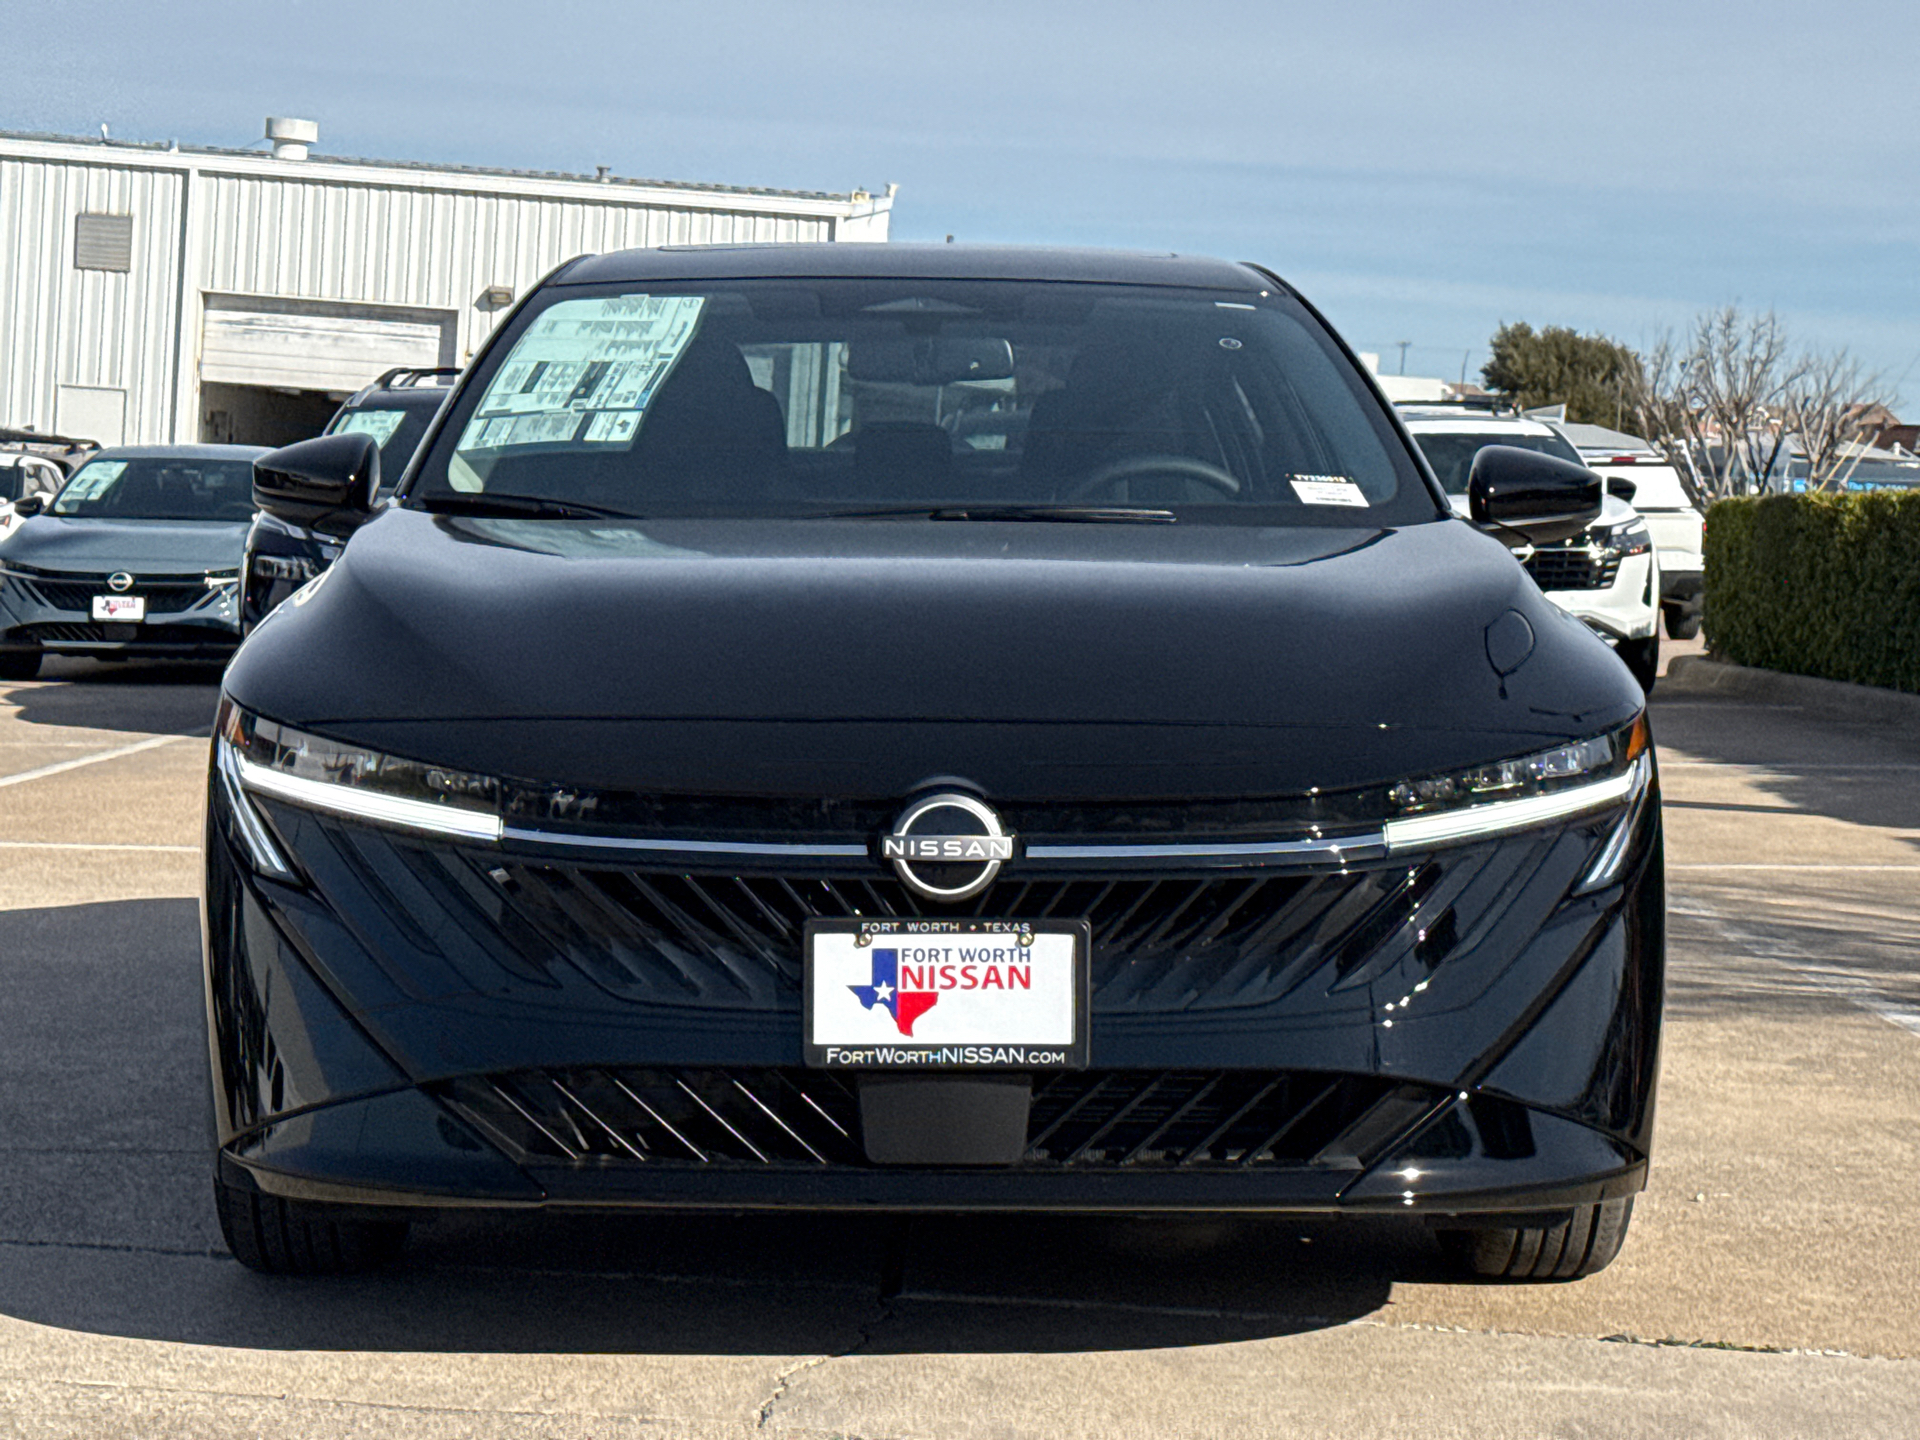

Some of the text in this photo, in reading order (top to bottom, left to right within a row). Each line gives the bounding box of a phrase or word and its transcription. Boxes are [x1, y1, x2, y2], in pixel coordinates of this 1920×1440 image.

[885, 839, 1008, 857] NISSAN
[861, 922, 1031, 933] FORT WORTH TEXAS
[901, 948, 1031, 963] FORT WORTH
[901, 965, 1031, 990] NISSAN
